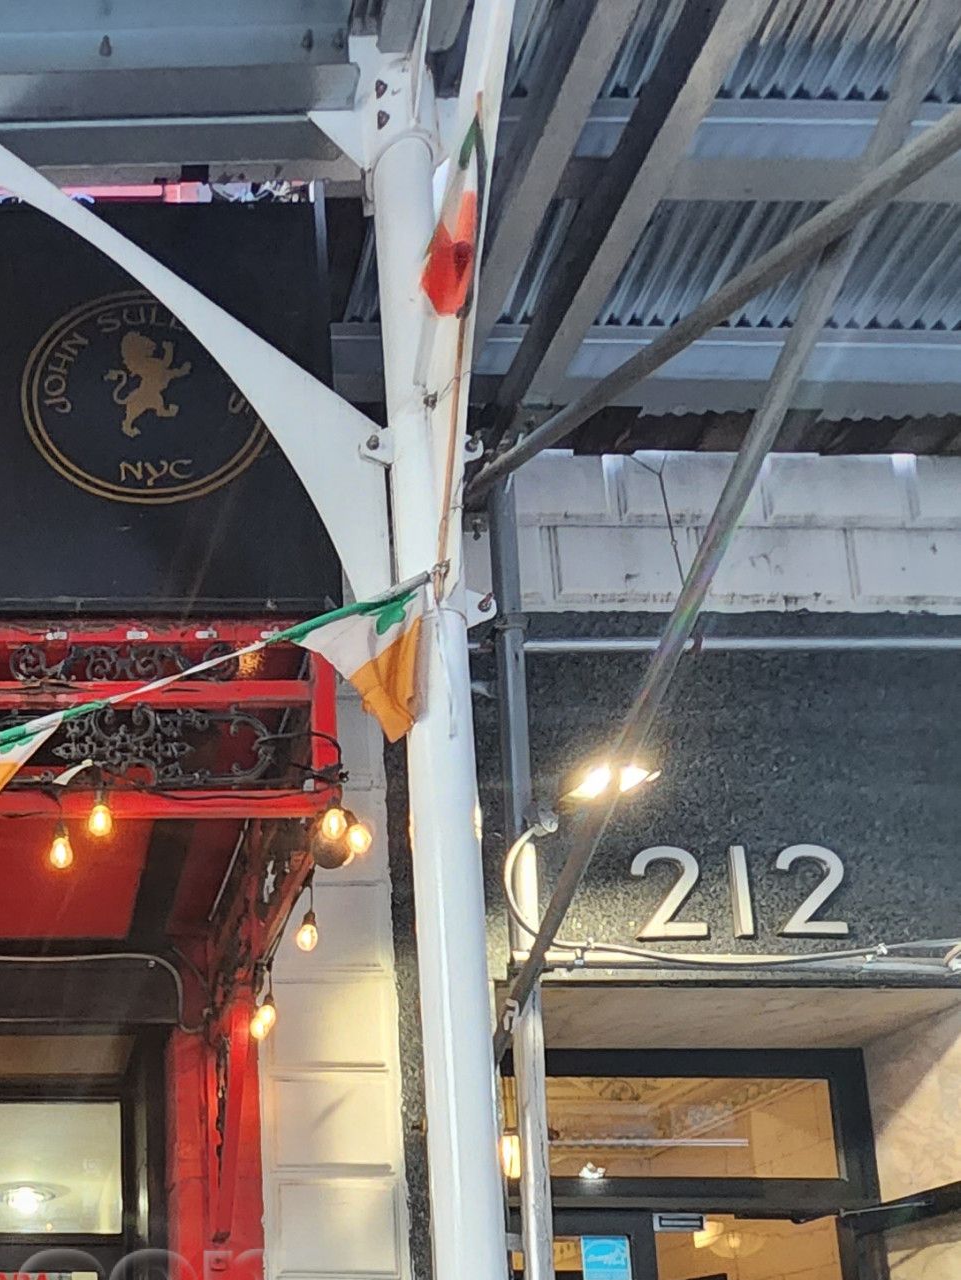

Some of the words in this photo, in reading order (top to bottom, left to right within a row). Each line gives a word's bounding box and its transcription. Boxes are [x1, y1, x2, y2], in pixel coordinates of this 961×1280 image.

[43, 333, 89, 414] JOHN
[119, 459, 194, 487] NYC
[629, 844, 850, 942] 212
